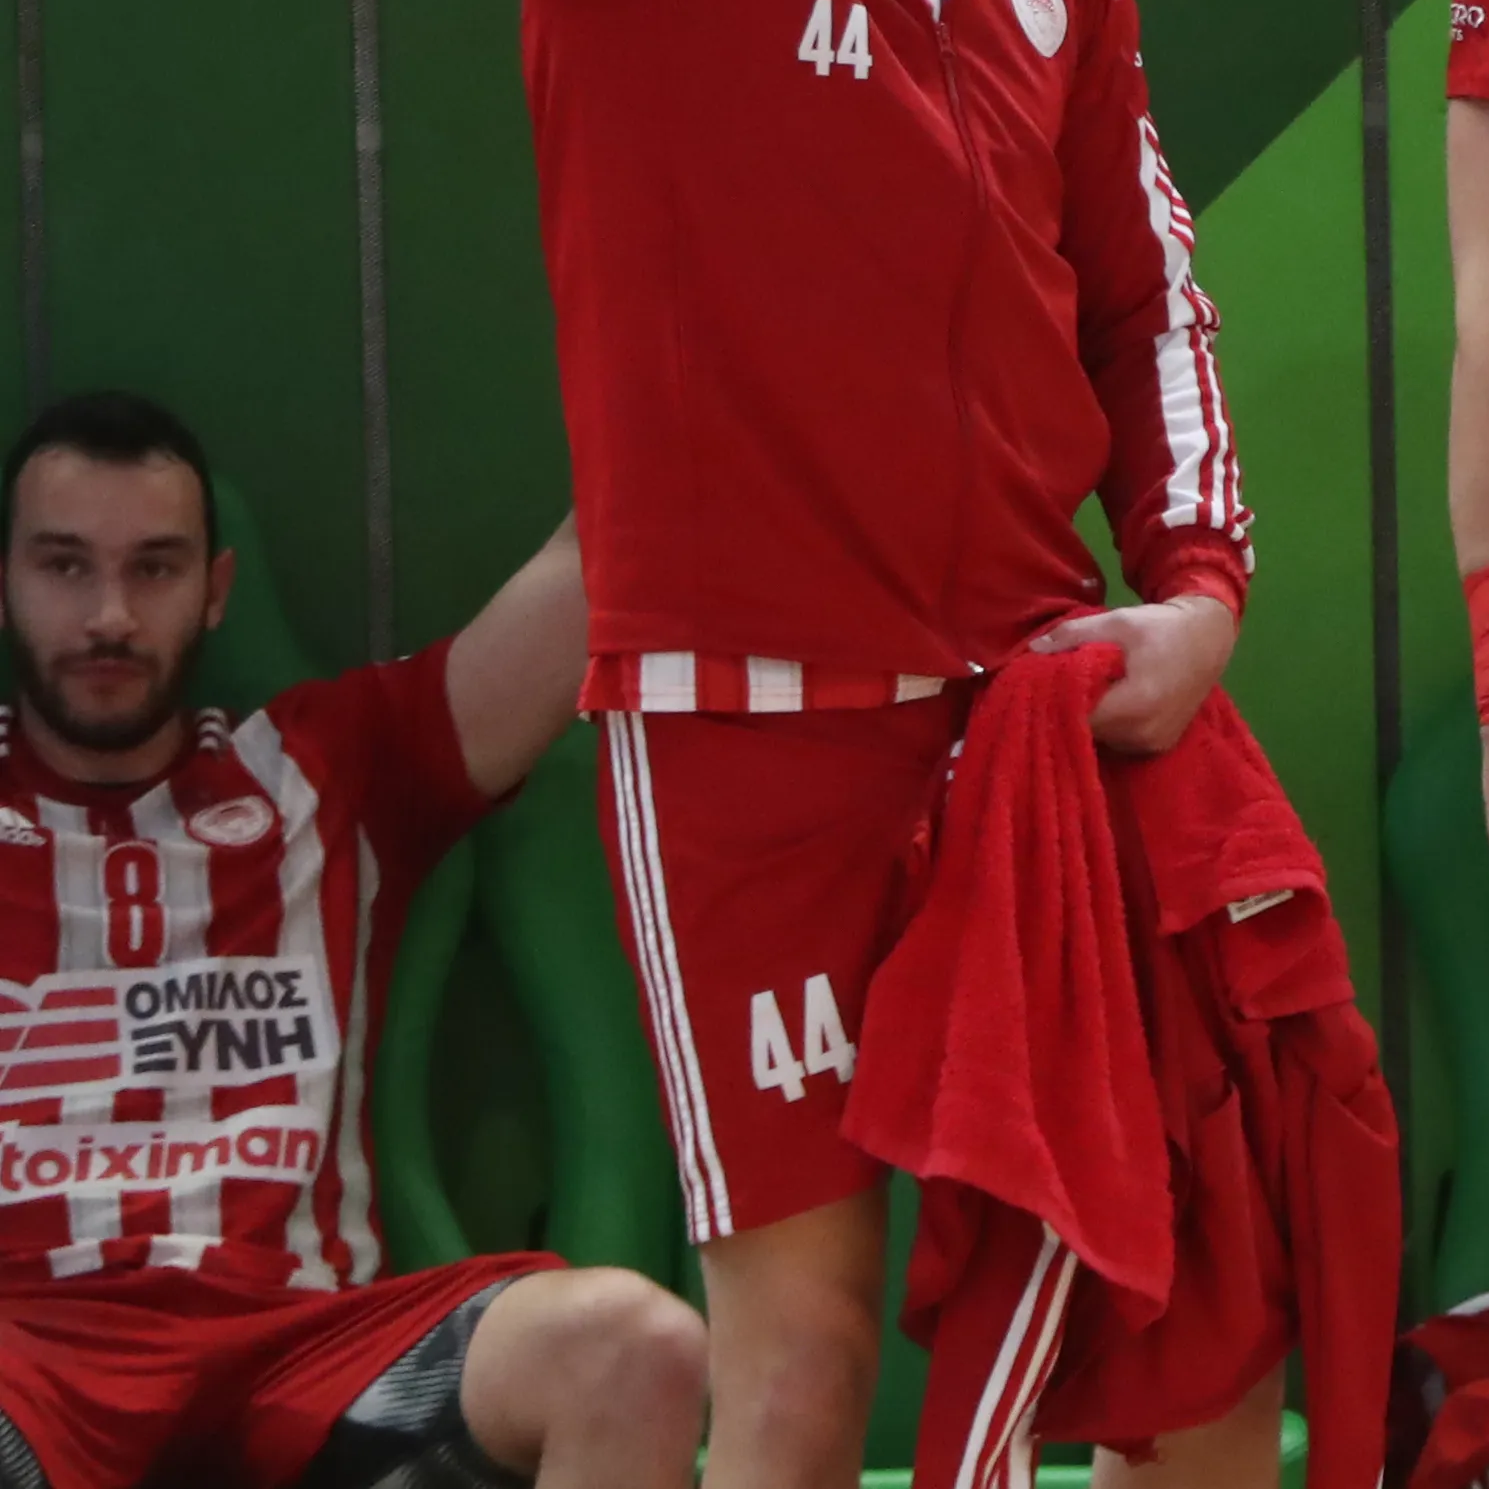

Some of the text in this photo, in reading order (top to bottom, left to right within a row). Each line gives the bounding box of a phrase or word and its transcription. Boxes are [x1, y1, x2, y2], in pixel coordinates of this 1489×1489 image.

[104, 841, 167, 966] 8
[126, 969, 308, 1019] ΟΜΙΛΟΣ
[131, 1015, 317, 1075] ΞΥΝΗ
[751, 973, 857, 1103] 44
[0, 1126, 320, 1192] toiximan
